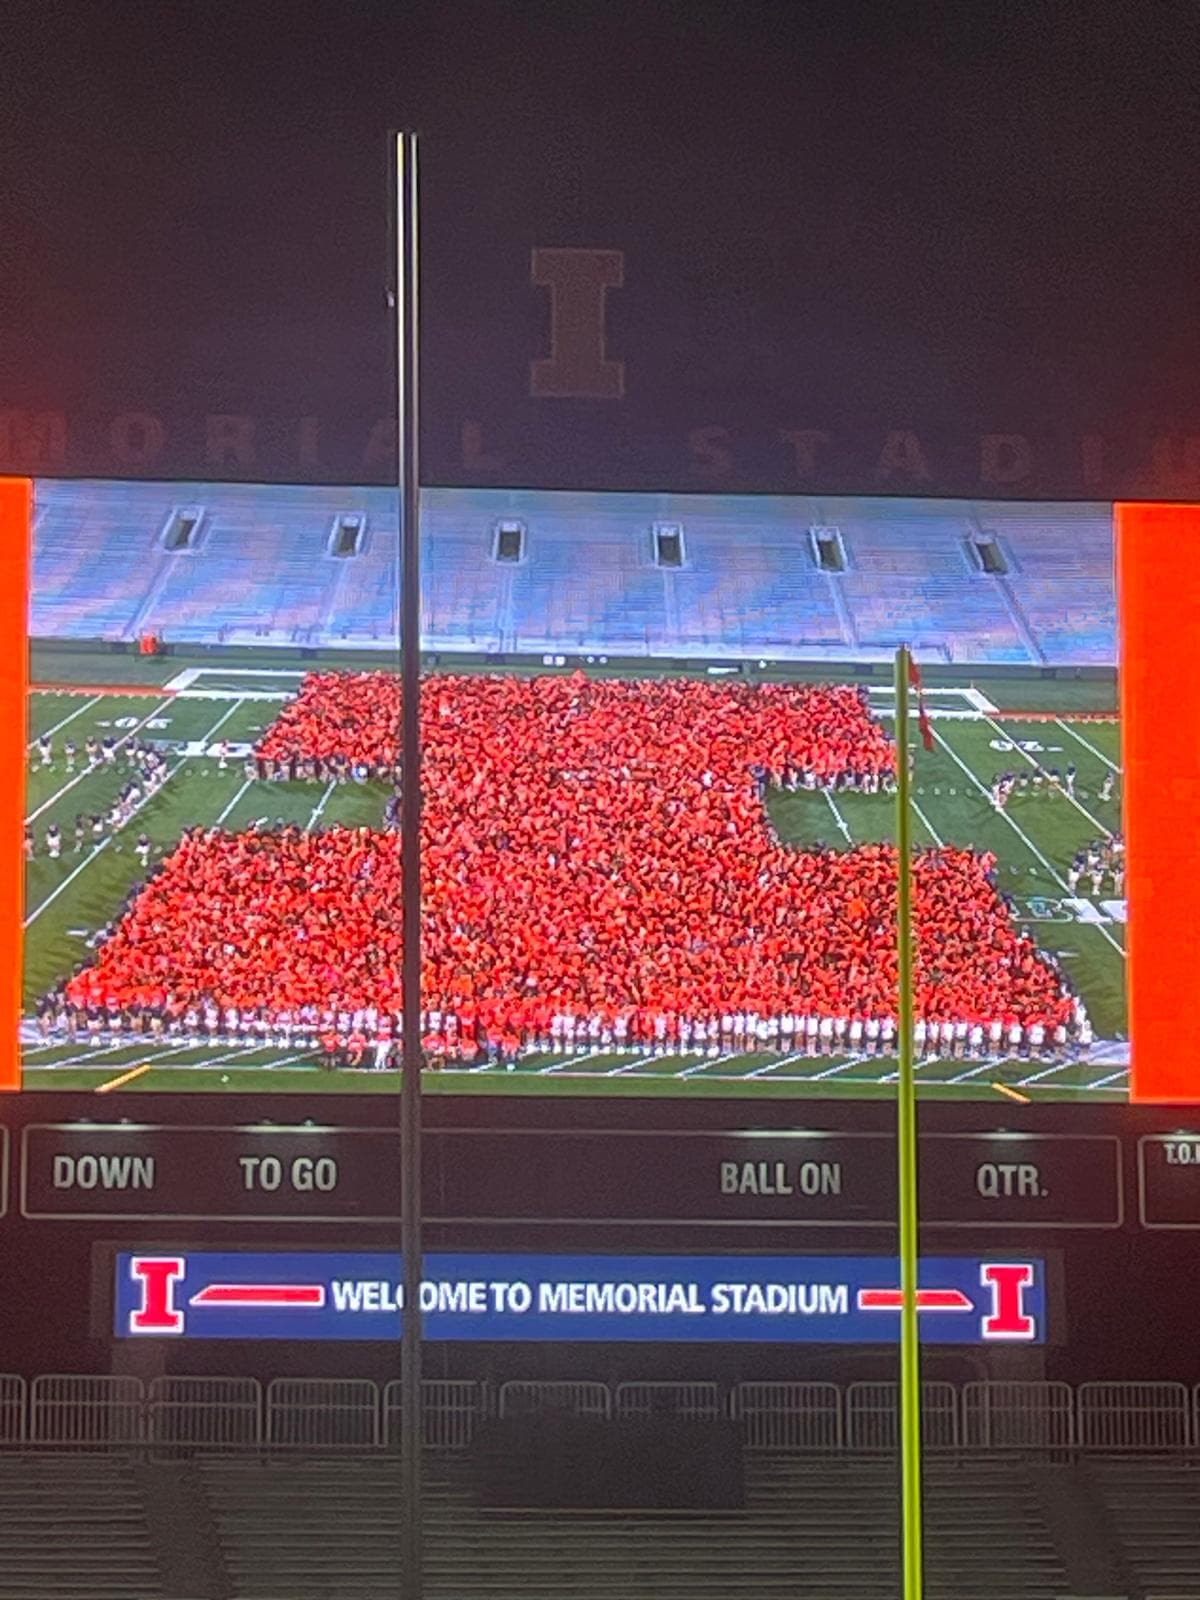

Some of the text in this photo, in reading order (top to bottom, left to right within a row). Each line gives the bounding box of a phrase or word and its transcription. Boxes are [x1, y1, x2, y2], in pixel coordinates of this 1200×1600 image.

[531, 248, 624, 398] I
[1163, 1142, 1200, 1165] T.O.
[53, 1156, 155, 1190] DOWN
[239, 1158, 338, 1192] TO GO
[720, 1163, 841, 1195] BALL ON
[977, 1165, 1049, 1197] QTR.
[130, 1256, 185, 1334] I
[490, 1282, 532, 1312] TO
[538, 1283, 706, 1313] MEMORIAL
[711, 1284, 849, 1314] STADIUM
[980, 1263, 1034, 1339] I
